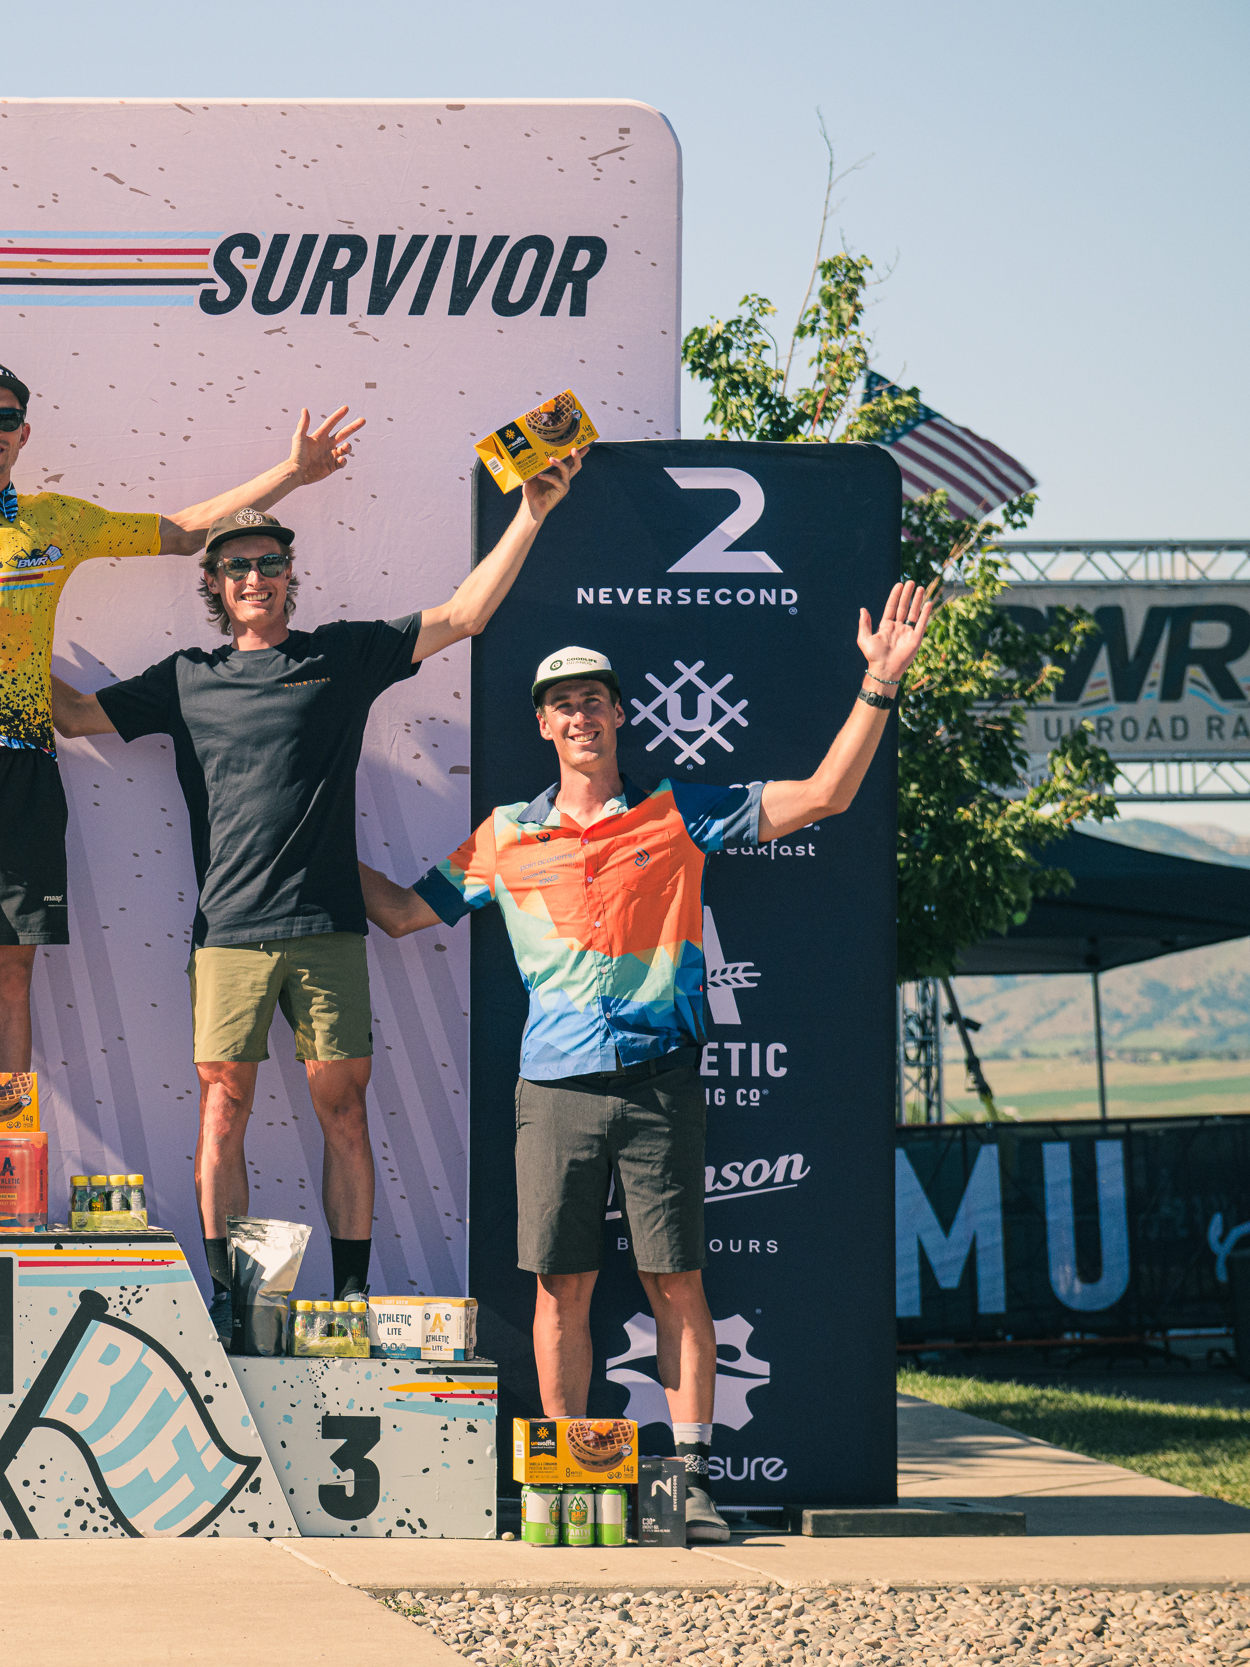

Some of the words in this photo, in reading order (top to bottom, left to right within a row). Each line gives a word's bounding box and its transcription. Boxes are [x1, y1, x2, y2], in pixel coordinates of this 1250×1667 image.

[198, 231, 607, 317] SURVIVOR
[18, 556, 49, 569] BWR
[577, 587, 798, 606] NEVERSECOND
[699, 1042, 788, 1078] ETIC
[709, 1239, 778, 1254] OURS
[378, 1313, 412, 1326] ATHLETIC
[387, 1328, 402, 1336] LITE
[426, 1335, 449, 1344] ATHLETIC
[319, 1416, 381, 1521] 3
[708, 1456, 788, 1481] sure
